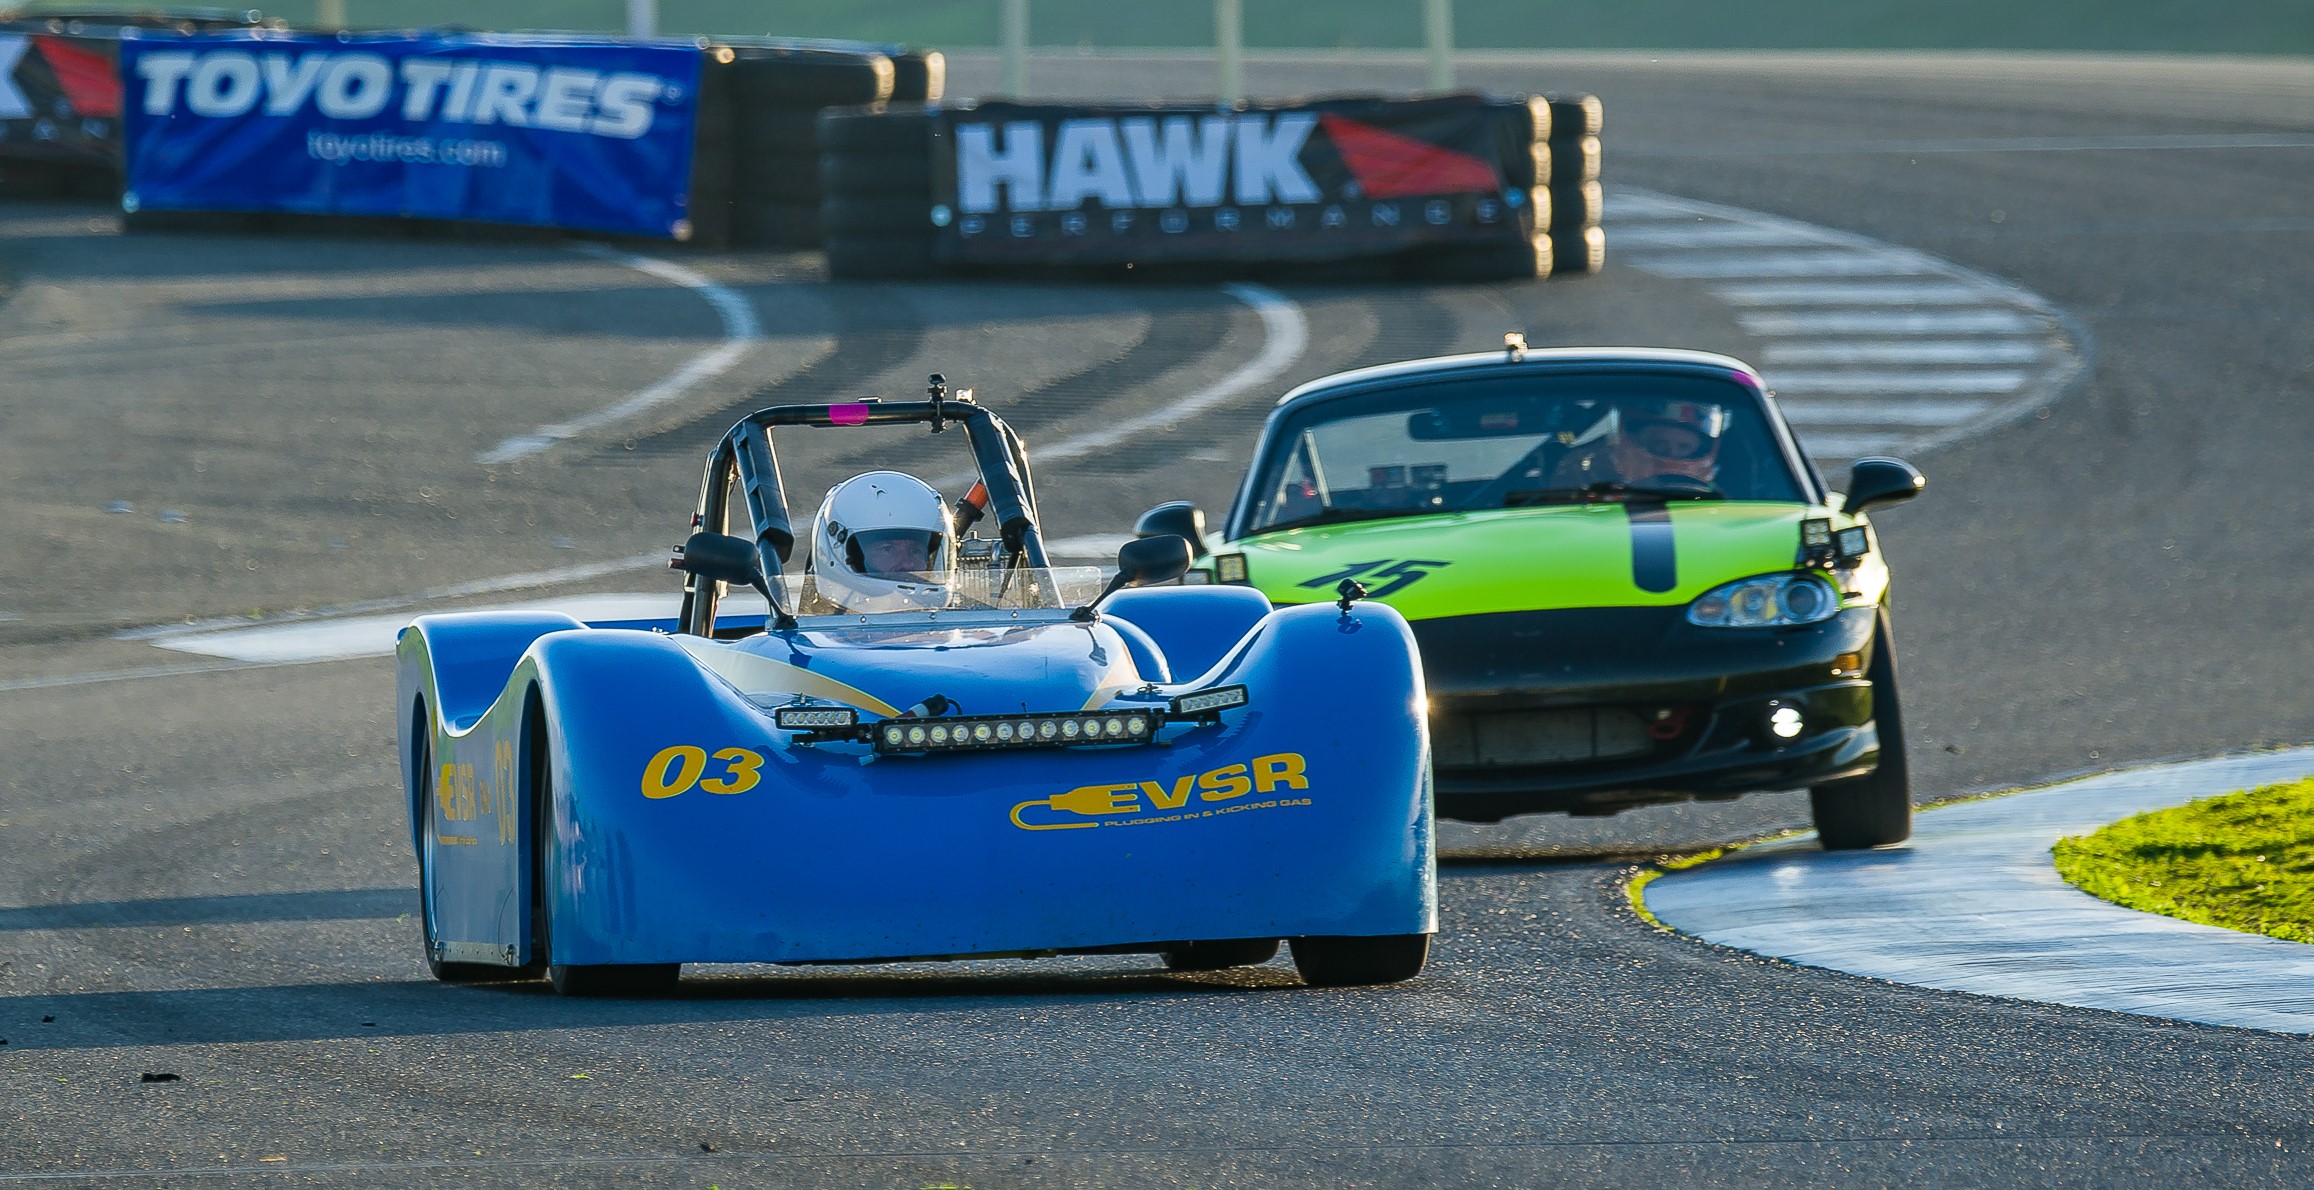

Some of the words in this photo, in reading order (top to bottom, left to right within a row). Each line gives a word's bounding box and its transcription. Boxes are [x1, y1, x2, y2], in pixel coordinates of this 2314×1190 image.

[136, 49, 396, 120] TOYO
[400, 56, 664, 140] TIRES
[307, 129, 508, 168] toyotires.com
[956, 110, 1322, 214] HAWK
[958, 198, 1504, 240] PERFORMANCE
[1295, 558, 1455, 599] 15
[641, 745, 765, 799] 03
[1076, 752, 1309, 818] EVSR
[1104, 813, 1181, 827] PLUGGING
[1184, 811, 1200, 820] IN
[1202, 809, 1213, 817] &
[1215, 799, 1278, 815] KICKING
[1280, 797, 1312, 807] GAS
